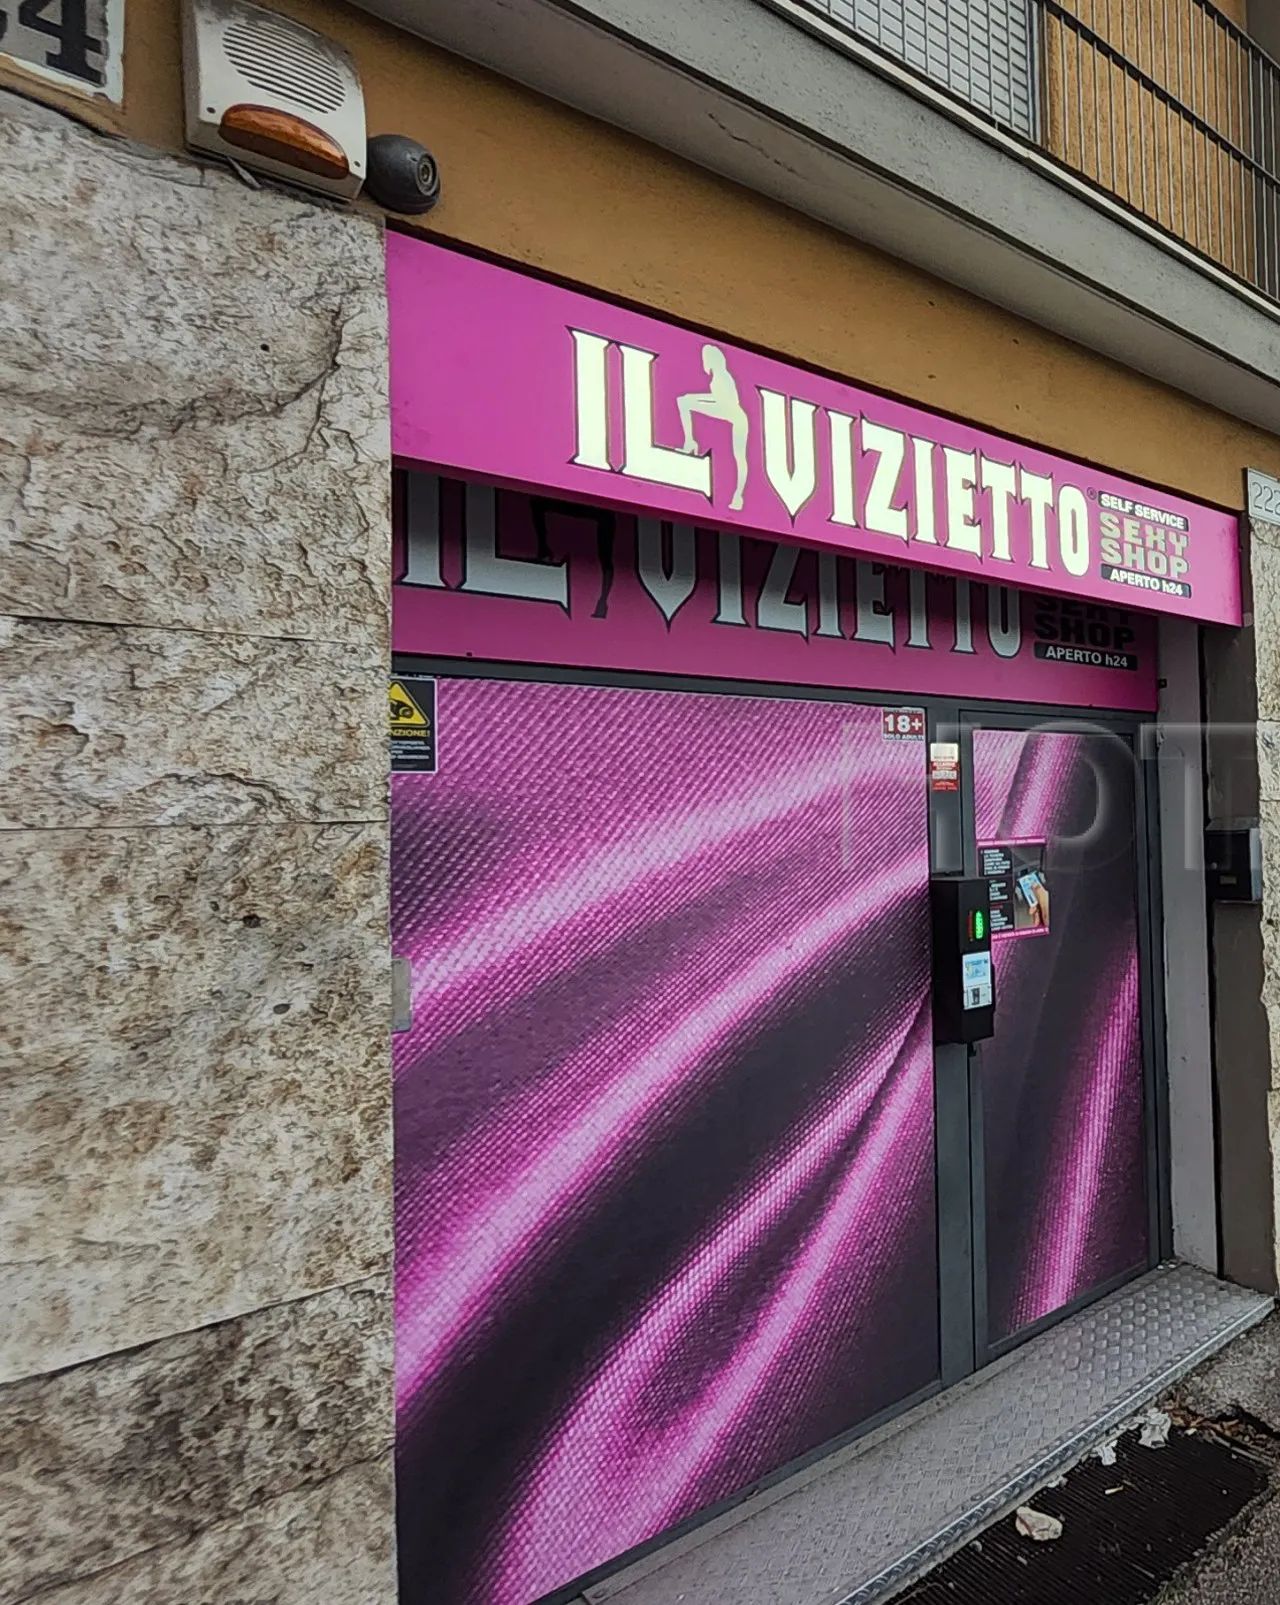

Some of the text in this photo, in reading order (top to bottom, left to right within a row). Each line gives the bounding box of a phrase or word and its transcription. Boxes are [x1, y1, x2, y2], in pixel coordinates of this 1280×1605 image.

[0, 0, 102, 85] 4
[569, 325, 1091, 578] IL VIZIETTO
[1100, 493, 1186, 530] SELF SERVICE
[1098, 511, 1189, 557] SEXY
[1099, 537, 1190, 580] SHOP
[1109, 568, 1184, 597] APERTO h24
[1034, 613, 1135, 650] SHOP
[1045, 645, 1129, 668] APERTO h24
[884, 713, 923, 733] 18+
